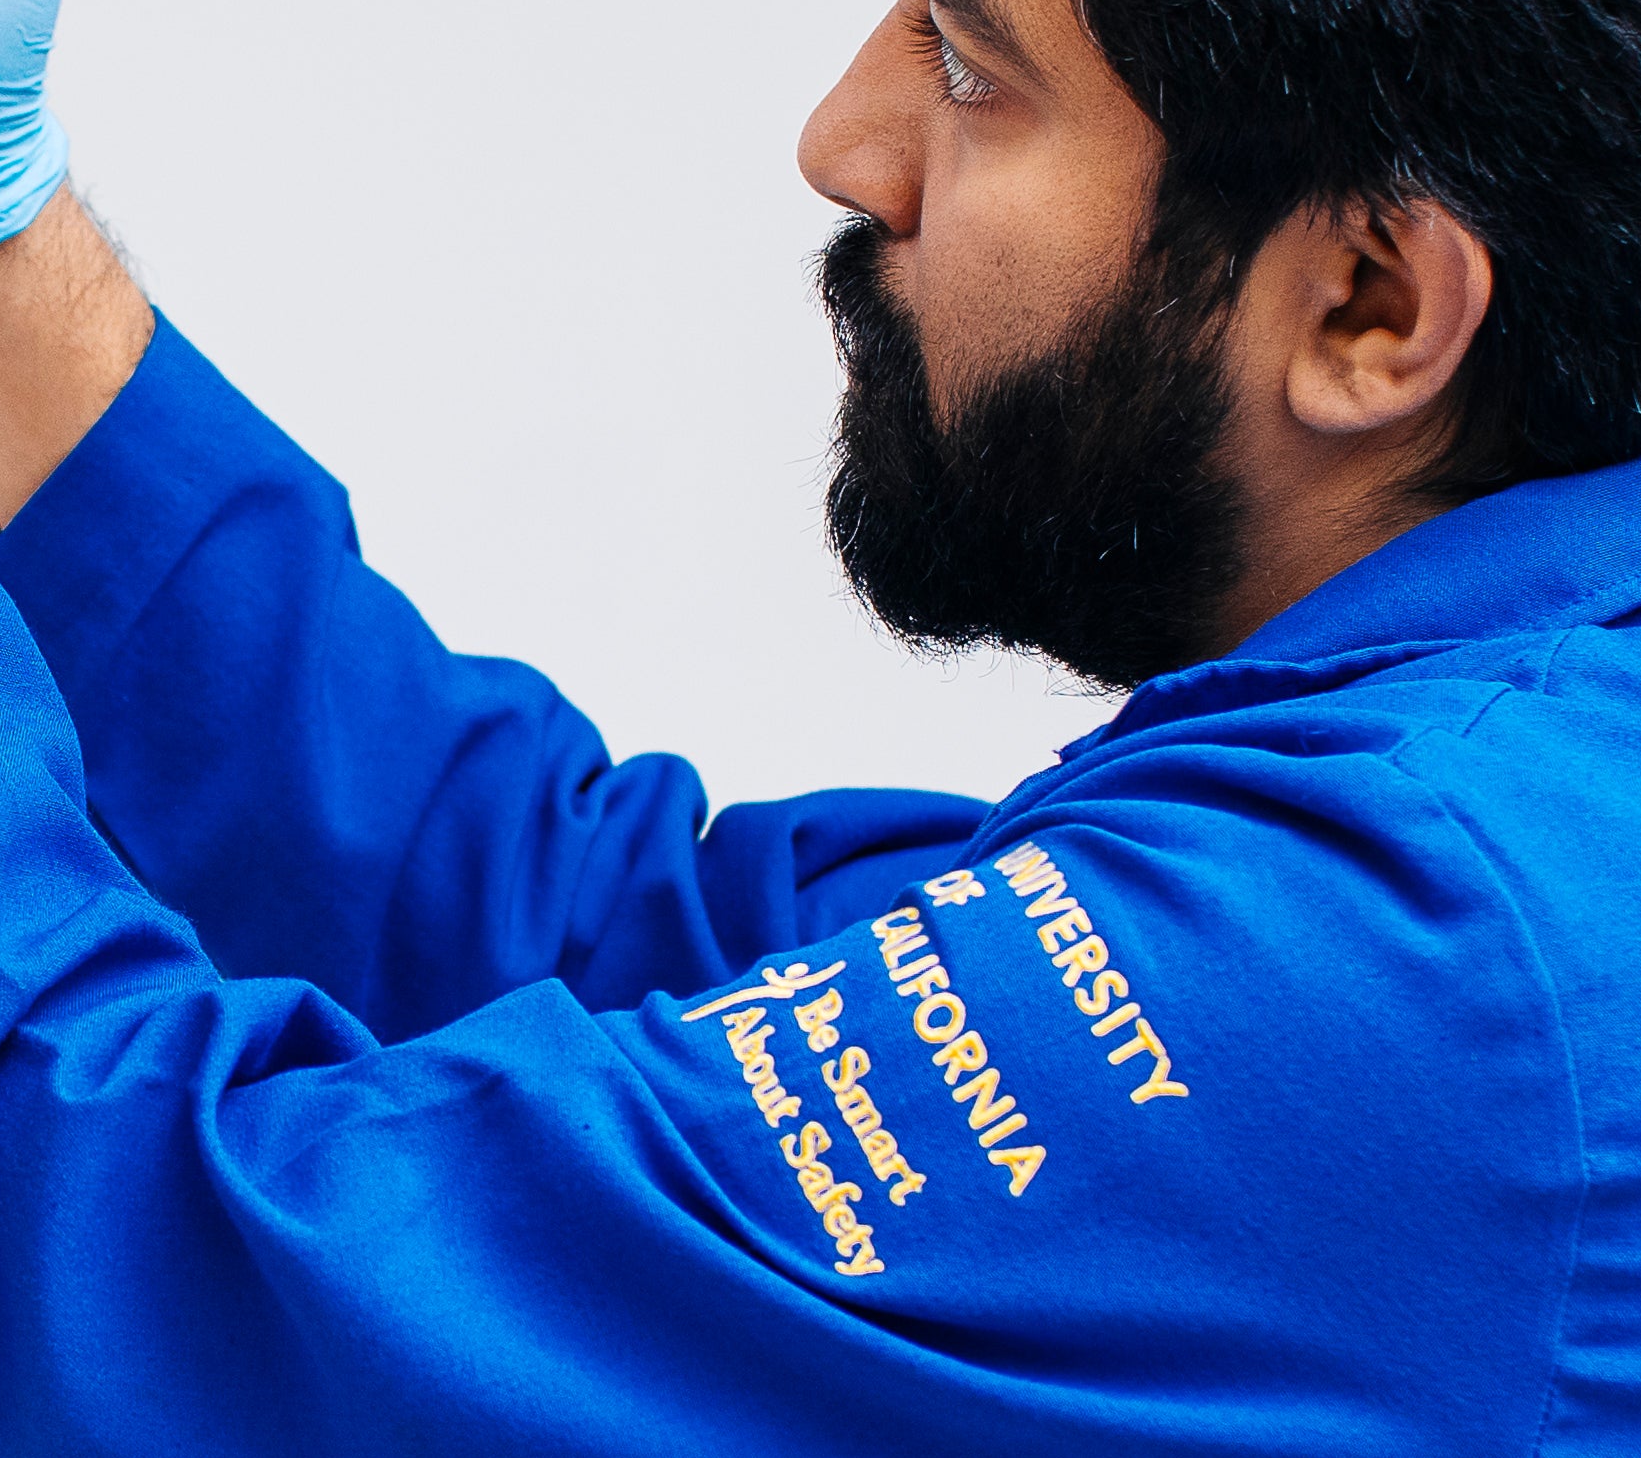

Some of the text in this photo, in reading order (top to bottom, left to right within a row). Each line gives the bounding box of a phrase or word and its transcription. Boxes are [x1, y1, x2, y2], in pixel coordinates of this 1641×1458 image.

[923, 868, 986, 908] OF
[994, 841, 1190, 1105] UNIVERSITY
[721, 1006, 885, 1275] About Safety
[793, 987, 927, 1206] Be Smart
[870, 905, 1047, 1197] CALIFORNIA
